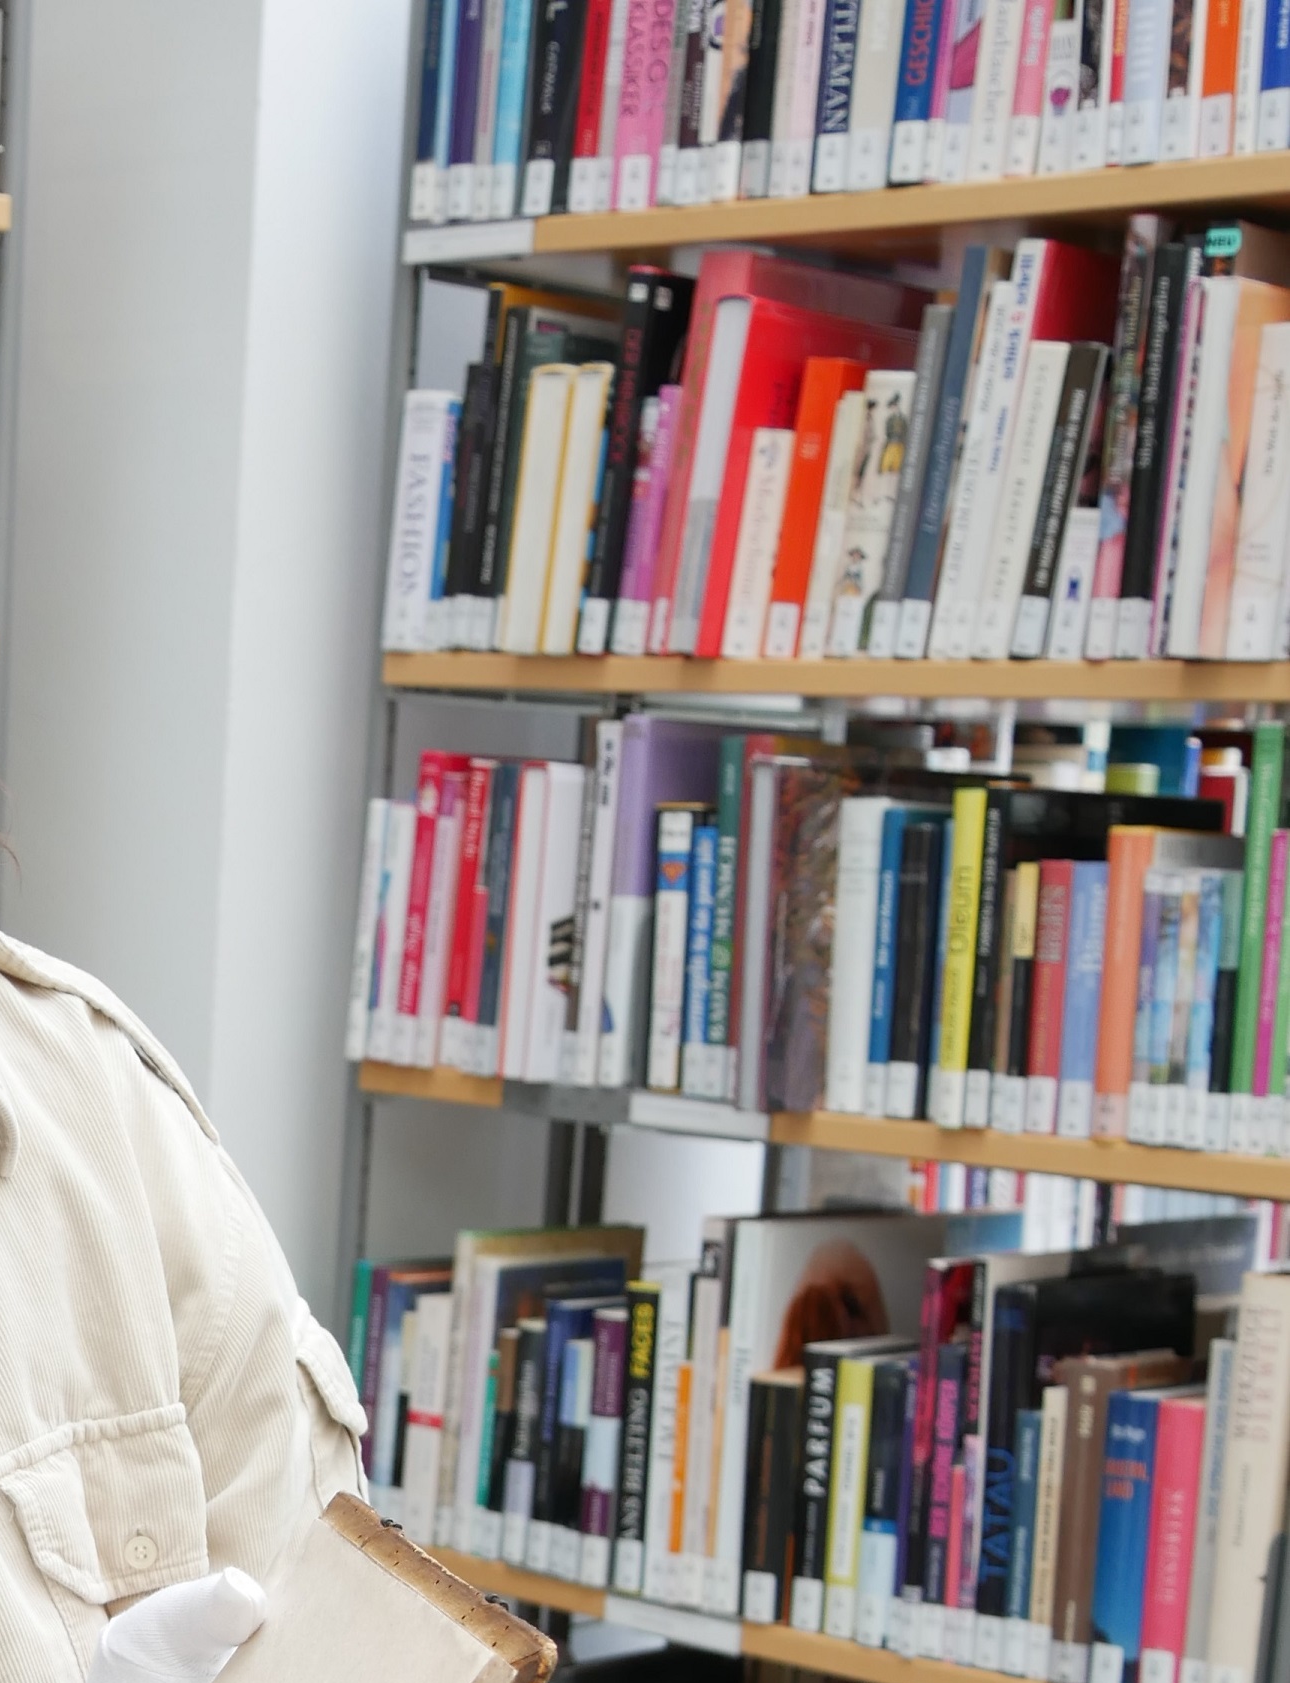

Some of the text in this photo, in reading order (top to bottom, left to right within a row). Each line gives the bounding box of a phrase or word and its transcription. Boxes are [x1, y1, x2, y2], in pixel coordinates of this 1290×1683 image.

[822, 0, 861, 132] TLEMAN
[398, 453, 431, 597] FASHION
[628, 1302, 655, 1380] FACES
[618, 1388, 650, 1539] ANS BELTING
[803, 1367, 835, 1498] PARFUM
